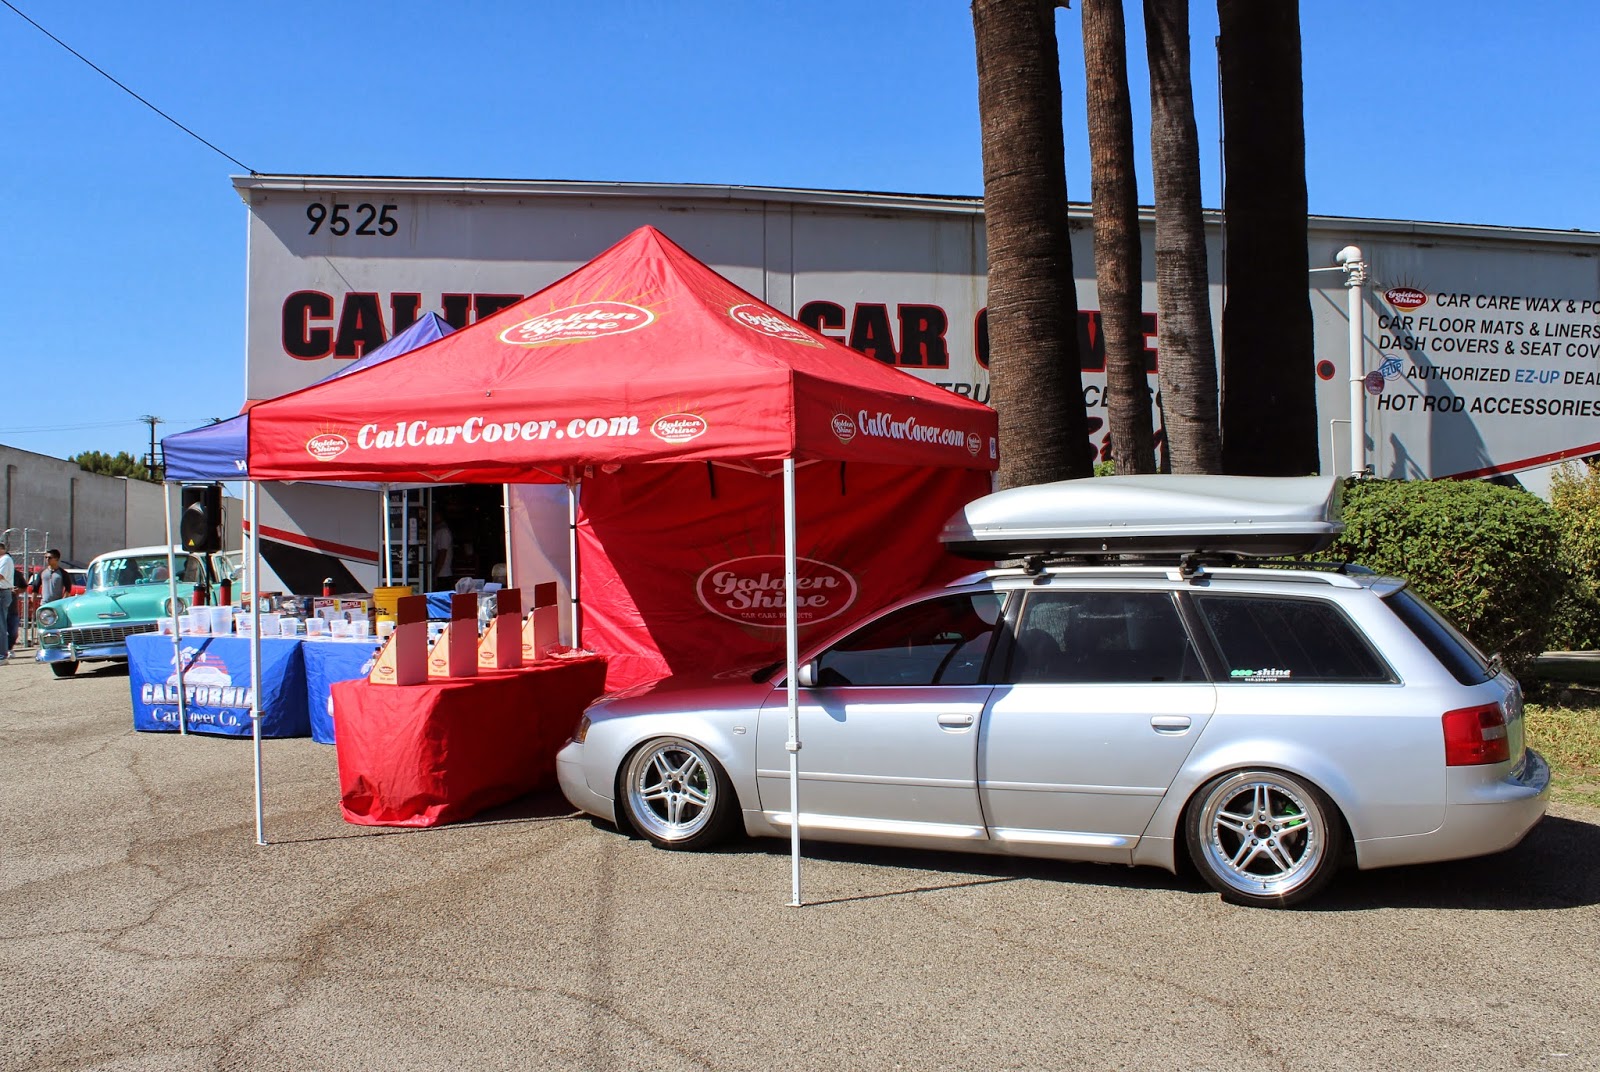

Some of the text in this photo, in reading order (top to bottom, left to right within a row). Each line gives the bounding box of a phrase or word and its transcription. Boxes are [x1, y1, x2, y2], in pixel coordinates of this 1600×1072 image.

[306, 203, 398, 236] 9525
[1388, 290, 1424, 299] Golden
[1436, 292, 1471, 308] CAR
[1476, 294, 1521, 311] CARE
[1525, 297, 1562, 312] WAX
[1566, 299, 1576, 314] &
[1378, 315, 1600, 339] CAR FLOOR MATS & LINERS
[1379, 335, 1426, 351] DASH
[1431, 338, 1499, 354] COVERS
[1504, 341, 1515, 355] &
[1520, 341, 1562, 357] SEAT
[1406, 366, 1511, 383] AUTHORIZED
[1515, 369, 1560, 384] EZ-UP
[1377, 394, 1600, 417] HOT ROD ACCESSORIES
[357, 415, 640, 449] CalCarCover.com
[658, 419, 702, 430] Golden
[661, 427, 698, 435] Shine
[858, 409, 965, 447] CalCarCover.com
[311, 439, 345, 449] Golden
[314, 445, 341, 453] Shine
[142, 683, 253, 708] CALFORNIA
[152, 708, 242, 727] Car over Co.
